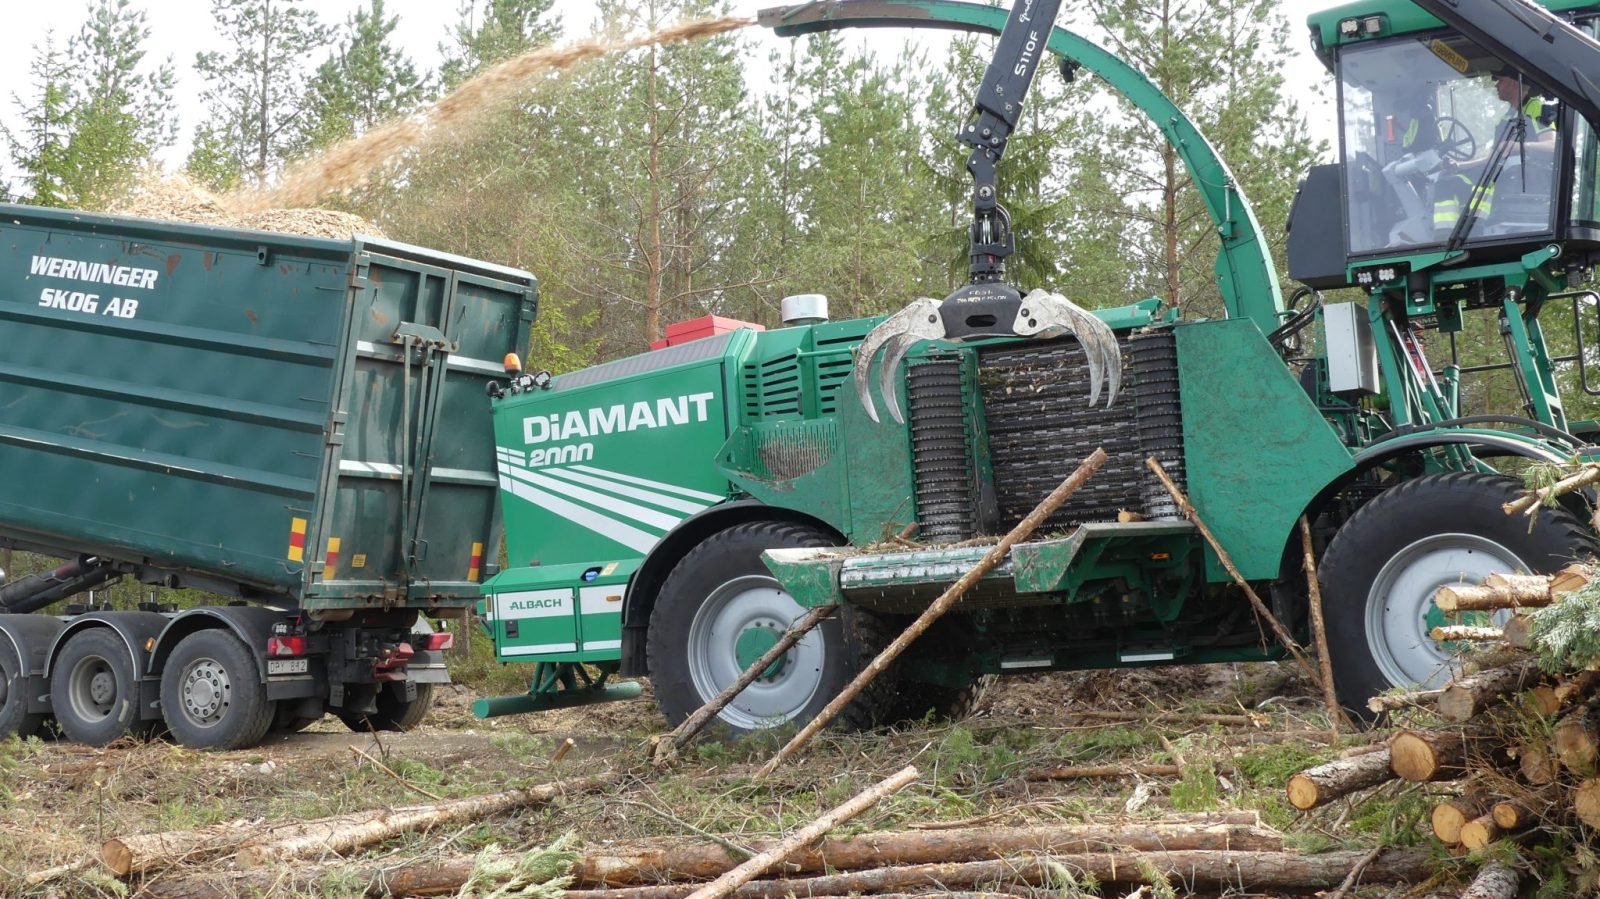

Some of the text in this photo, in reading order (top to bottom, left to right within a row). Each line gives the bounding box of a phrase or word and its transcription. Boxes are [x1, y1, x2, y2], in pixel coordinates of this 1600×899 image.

[1014, 31, 1038, 76] S110F
[30, 255, 159, 289] WERNINGER
[38, 287, 139, 319] SKOG AB
[529, 442, 594, 467] 2000
[509, 598, 562, 611] ALBACH
